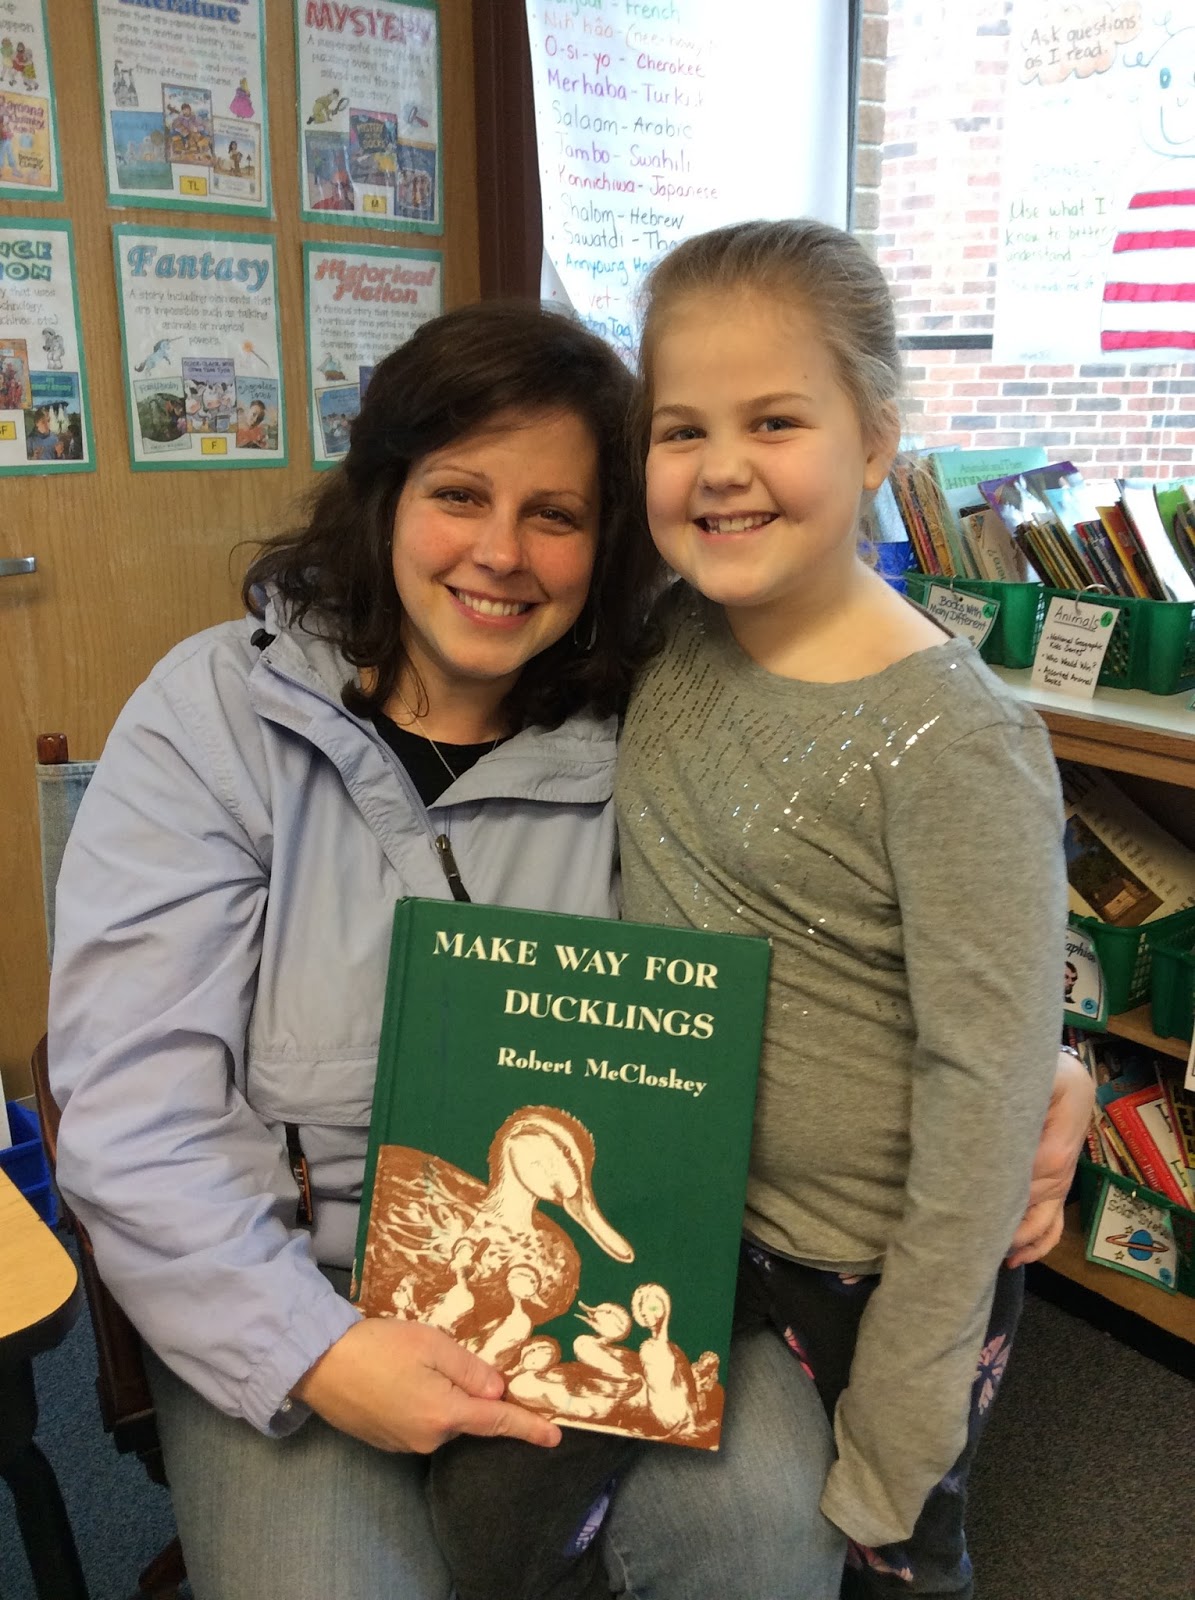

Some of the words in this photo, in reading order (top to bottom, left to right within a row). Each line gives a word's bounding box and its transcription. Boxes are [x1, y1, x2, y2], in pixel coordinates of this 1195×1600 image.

[1030, 25, 1062, 47] Ask
[1067, 14, 1136, 47] questions
[636, 52, 705, 78] Cherokee
[1025, 56, 1043, 70] as
[1048, 47, 1061, 65] I
[548, 68, 628, 101] Merhaba
[552, 100, 618, 136] Salaam
[633, 116, 694, 139] Arabic
[630, 144, 691, 173] Swahili
[187, 180, 200, 191] TL
[630, 208, 684, 230] Hebrew
[1009, 199, 1040, 220] Use
[1049, 198, 1085, 217] what
[127, 244, 270, 293] Fantasy
[139, 290, 165, 303] story
[167, 291, 206, 304] including
[154, 306, 200, 318] impossible
[202, 308, 222, 318] such
[238, 308, 268, 321] talking
[162, 321, 197, 331] animals
[939, 595, 964, 612] Books
[950, 610, 986, 631] Different
[1054, 605, 1100, 630] Animals
[1046, 653, 1058, 663] Who
[1061, 657, 1078, 668] Would
[433, 931, 538, 966] MAKE
[554, 944, 629, 977] WAY
[644, 956, 719, 990] FOR
[504, 989, 715, 1039] DUCKLINGS
[497, 1047, 572, 1075] Robert
[584, 1058, 707, 1098] McCloskey
